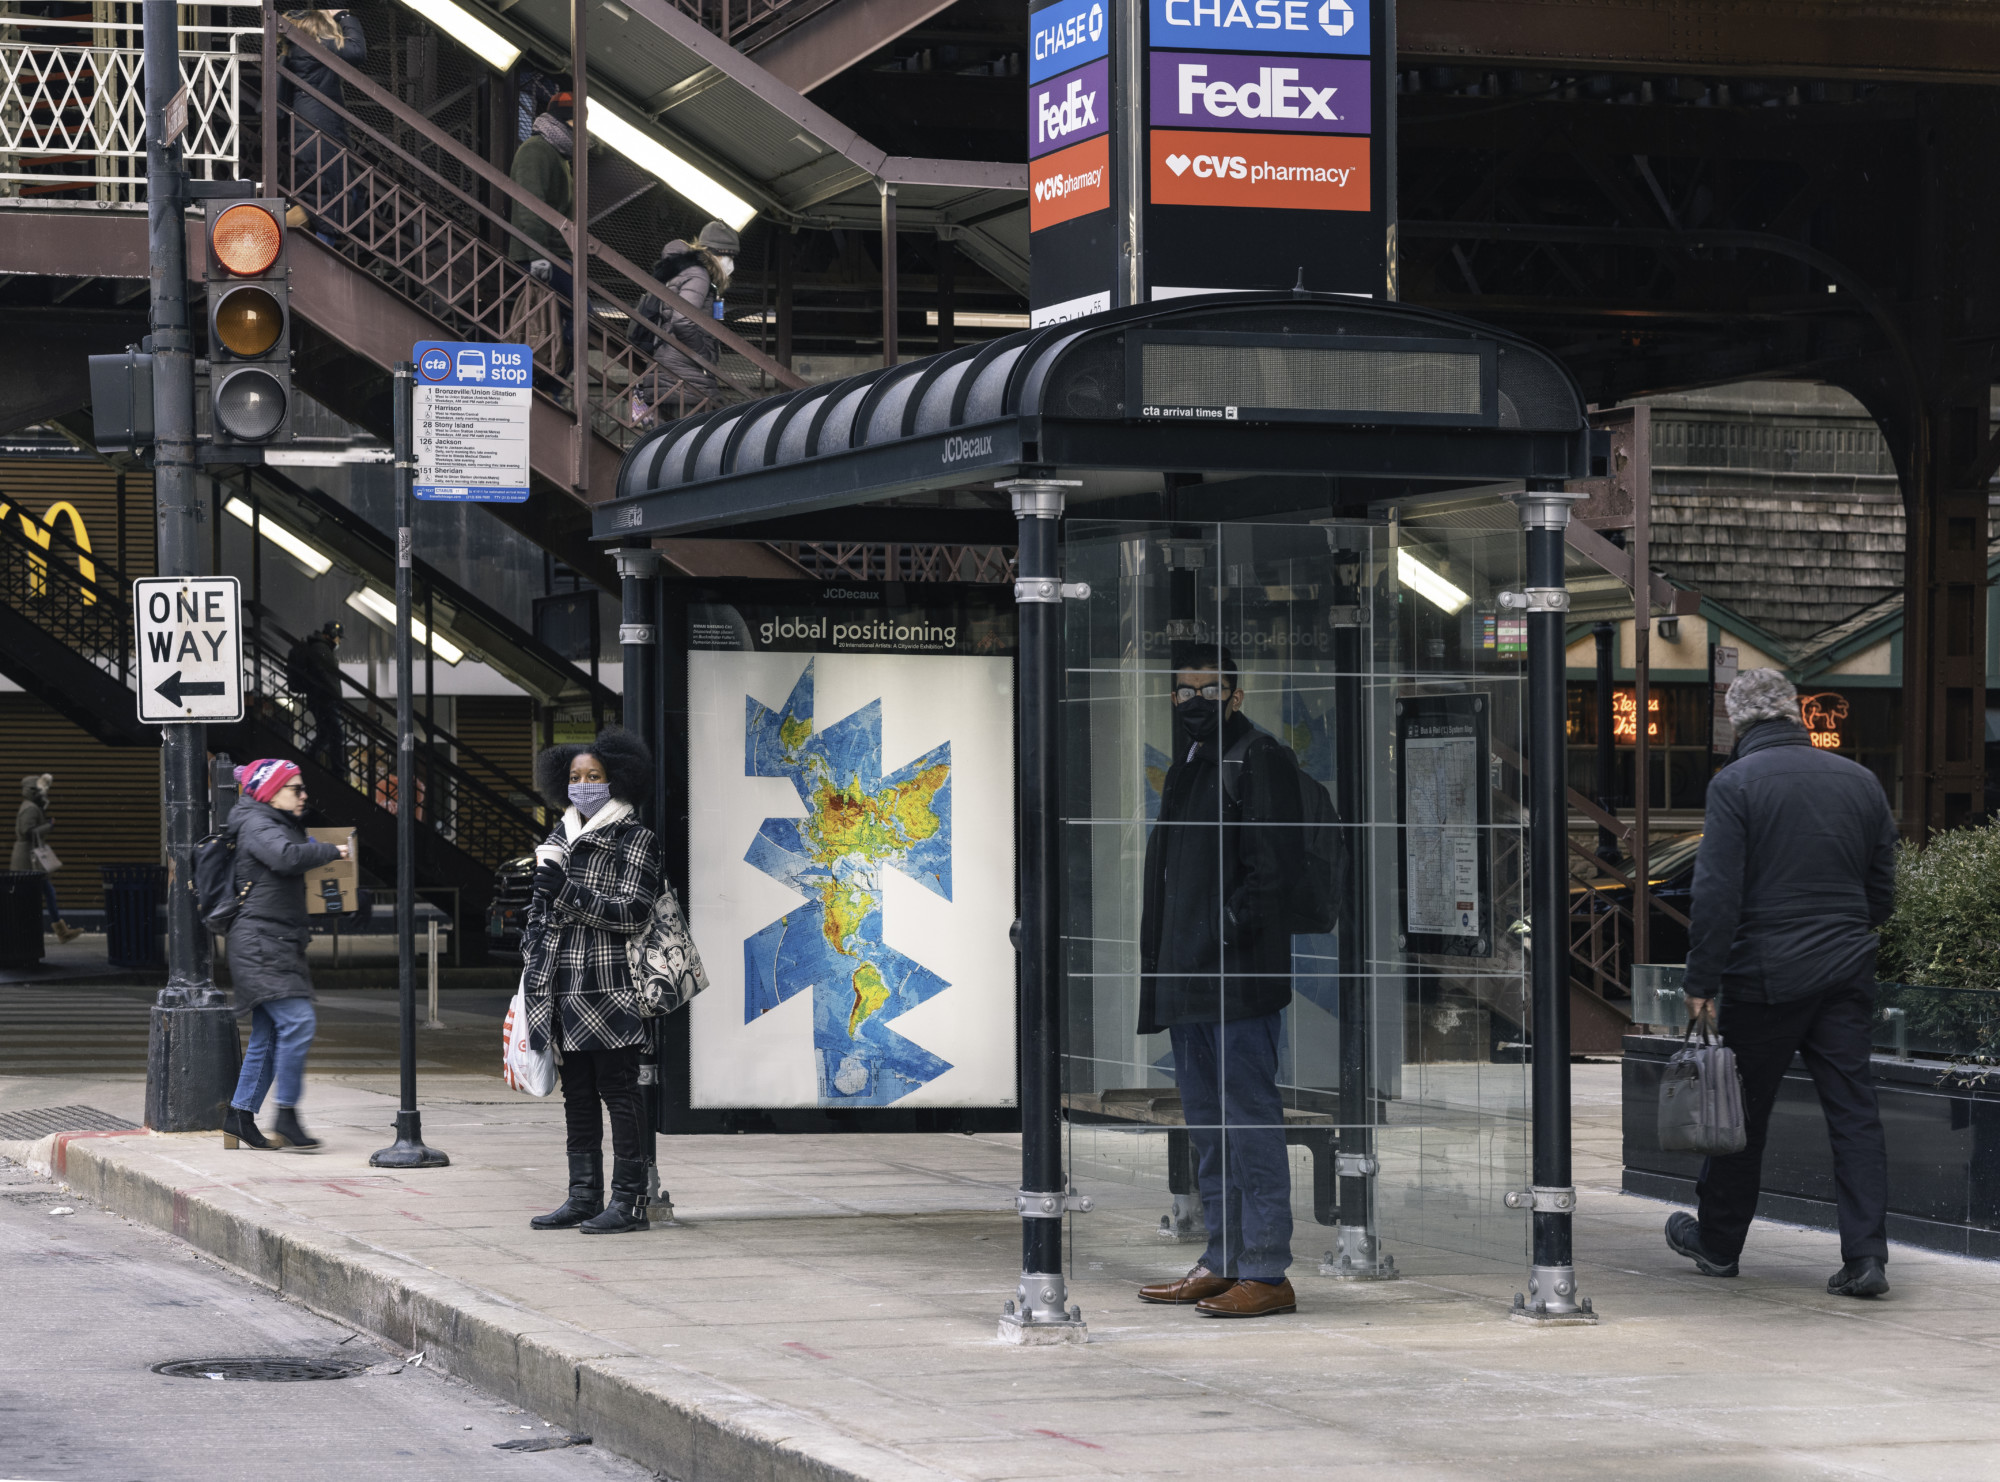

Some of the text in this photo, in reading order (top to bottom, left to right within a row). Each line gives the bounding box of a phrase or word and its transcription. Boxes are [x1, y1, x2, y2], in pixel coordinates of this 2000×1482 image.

[1165, 0, 1310, 31] CHASE
[1035, 13, 1087, 61] CHASE
[1179, 63, 1339, 121] FedEx
[1038, 79, 1097, 144] FedEx
[1192, 154, 1248, 180] CVS
[1043, 173, 1064, 201] CVS
[425, 358, 447, 370] cta
[491, 349, 521, 366] bus
[491, 366, 527, 385] stop
[1143, 406, 1223, 418] cta arrival times
[942, 436, 993, 464] JCDecaux
[149, 591, 225, 624] ONE
[823, 588, 880, 600] JCDecaux
[760, 616, 957, 648] global positioning
[147, 630, 228, 663] WAY
[1810, 732, 1841, 748] RIBS
